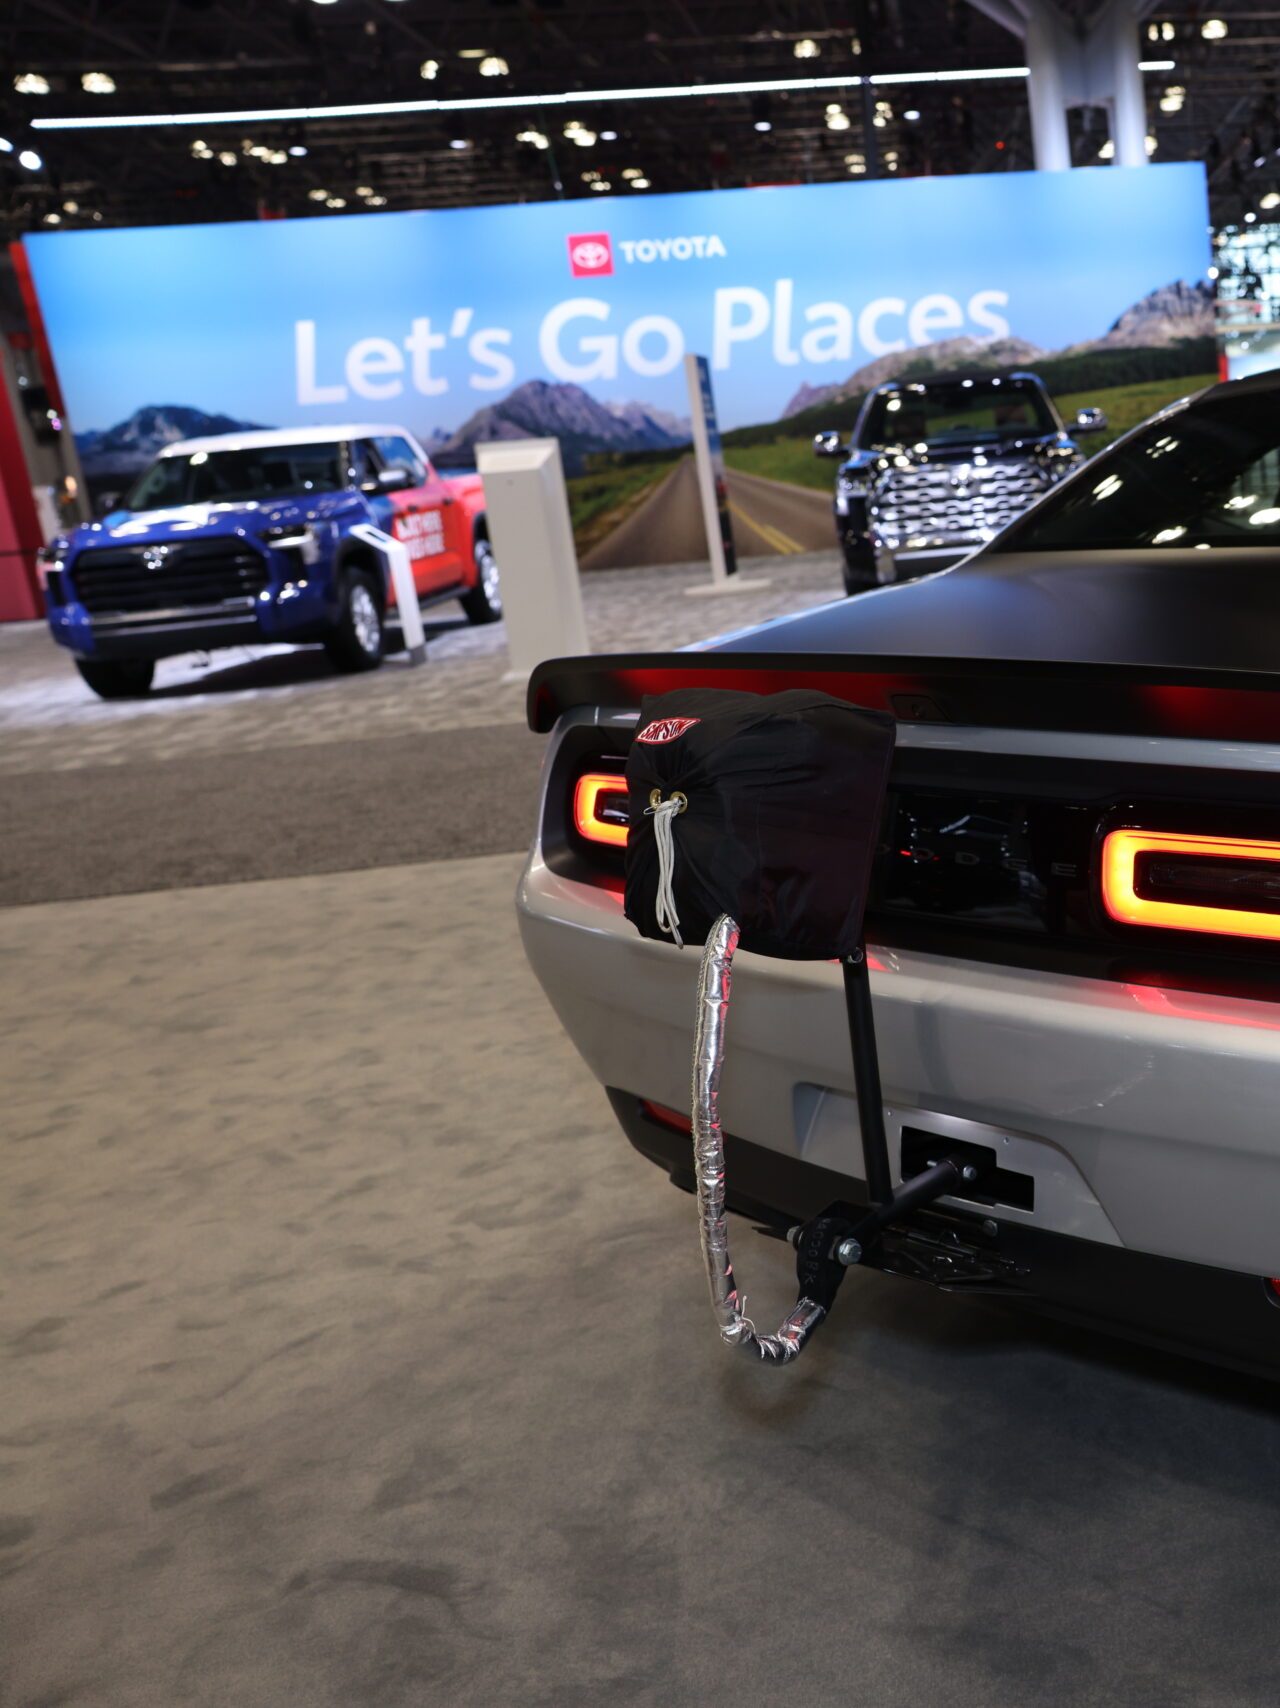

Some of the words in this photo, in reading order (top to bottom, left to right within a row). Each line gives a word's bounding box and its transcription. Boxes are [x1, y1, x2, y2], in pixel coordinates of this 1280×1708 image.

[619, 235, 727, 264] TOYOTA
[538, 298, 685, 383] Go
[712, 278, 1010, 370] Places
